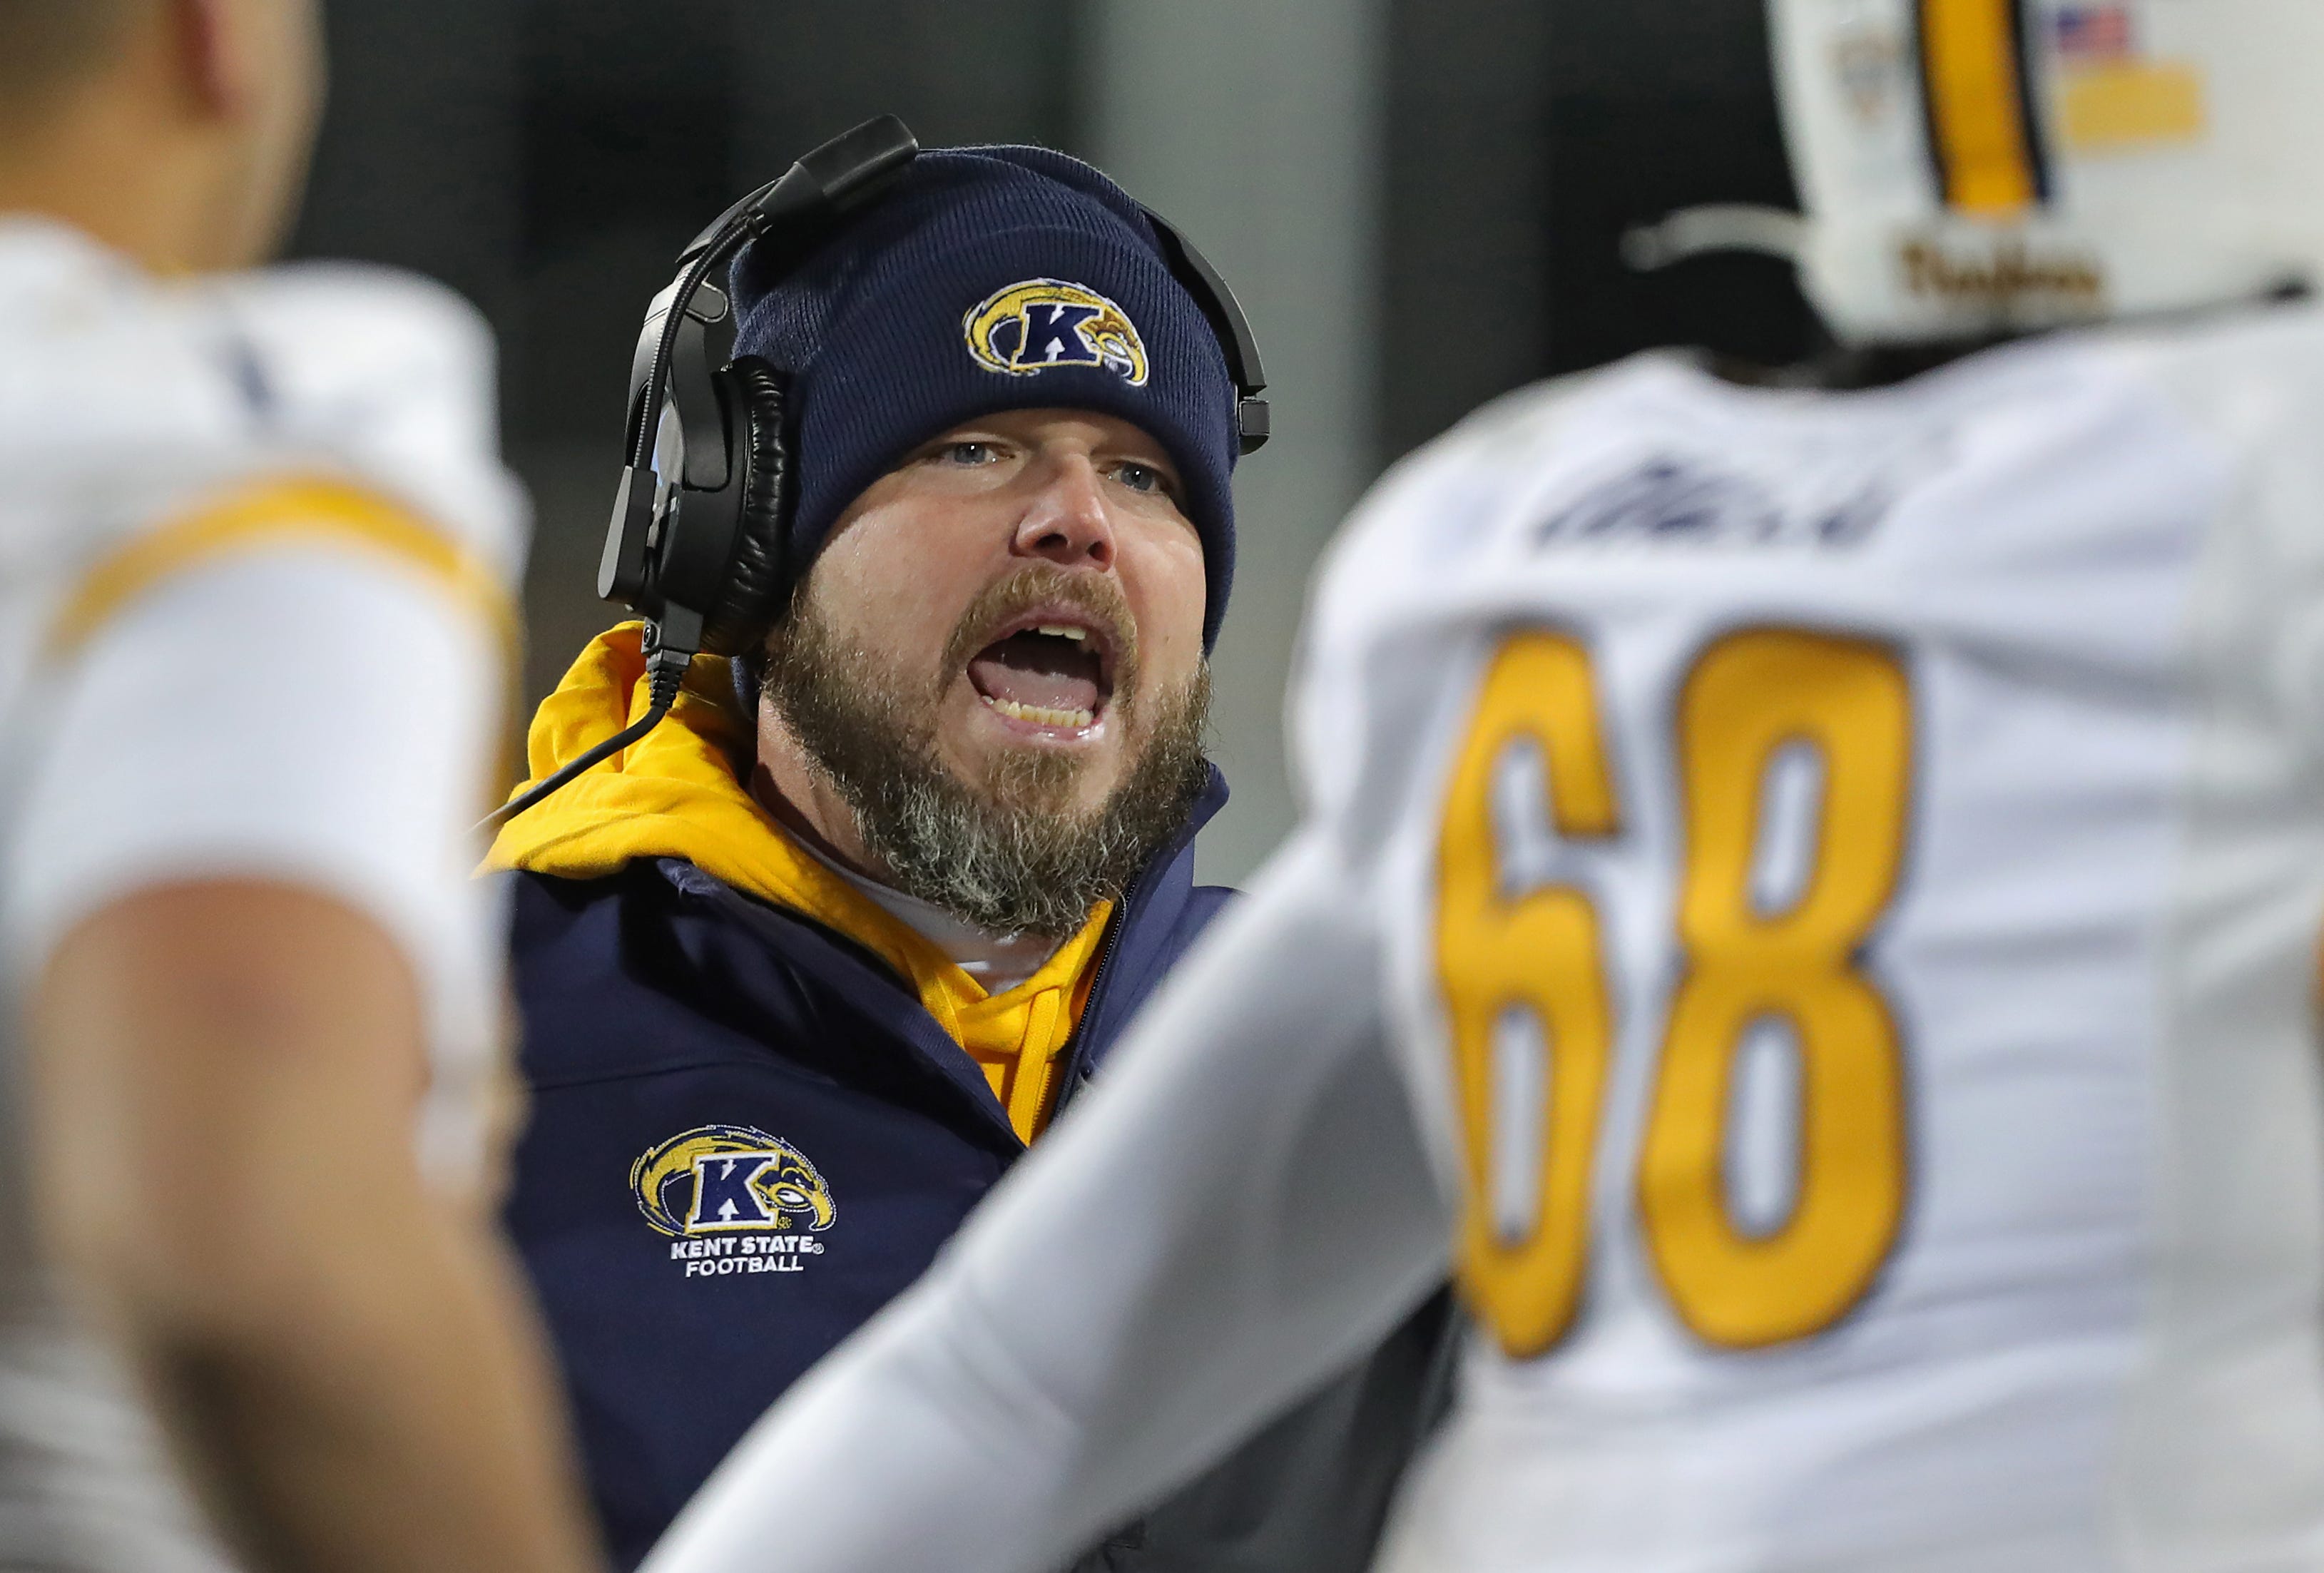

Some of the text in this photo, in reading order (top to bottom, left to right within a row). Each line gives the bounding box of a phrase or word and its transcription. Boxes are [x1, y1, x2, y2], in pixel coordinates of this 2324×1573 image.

[1010, 302, 1105, 369] K
[1435, 625, 1912, 1361] 68
[686, 1149, 780, 1233] K
[671, 1237, 737, 1259] KENT
[686, 1256, 804, 1277] FOOTBALL
